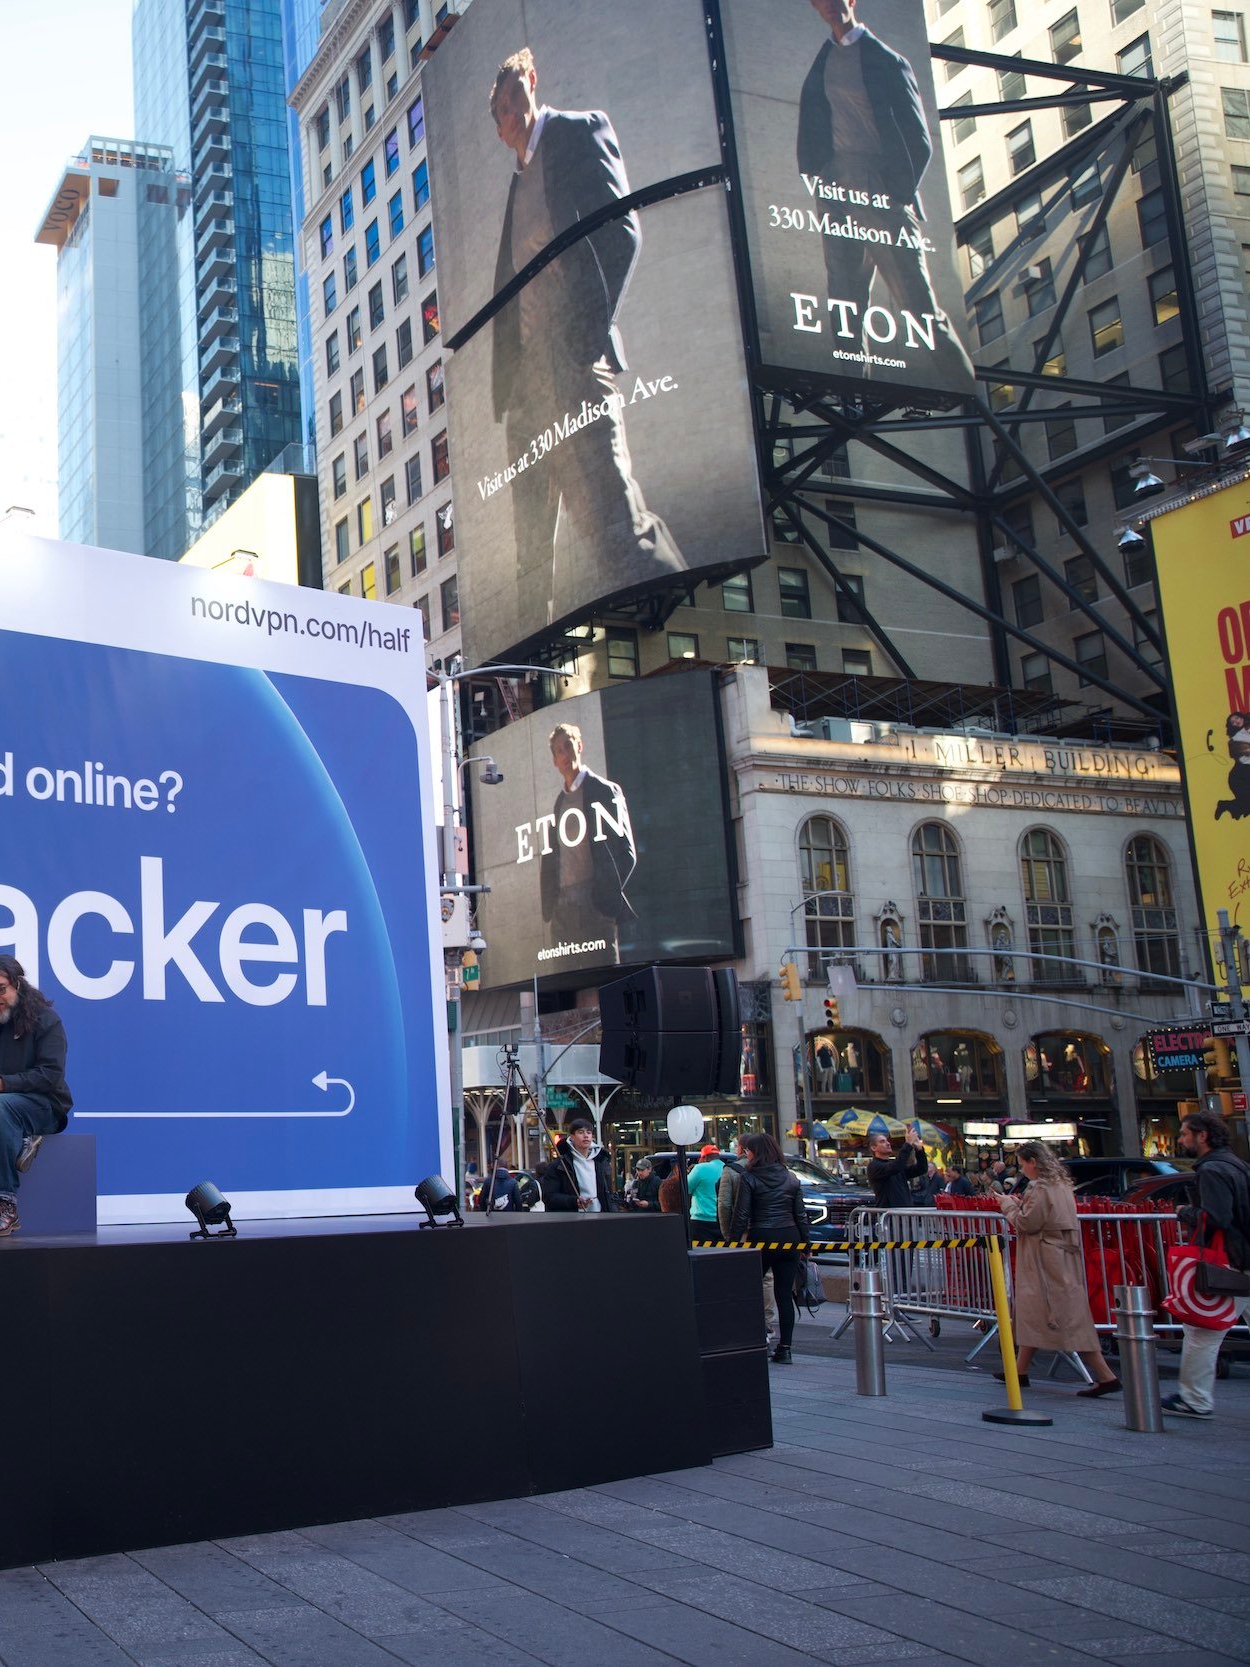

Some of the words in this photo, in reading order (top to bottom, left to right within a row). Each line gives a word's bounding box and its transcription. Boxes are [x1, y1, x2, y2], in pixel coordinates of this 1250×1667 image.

[801, 173, 846, 202] Visit
[849, 189, 869, 206] us
[872, 192, 890, 209] at
[768, 205, 804, 230] 330
[807, 210, 892, 246] Madison
[895, 226, 936, 253] Ave.
[790, 292, 935, 351] ETON
[833, 349, 906, 369] etonshirts.com
[477, 471, 503, 500] Visit
[504, 461, 517, 482] us
[517, 453, 530, 473] at
[530, 429, 553, 465] 330
[553, 393, 627, 446] Madison
[629, 375, 679, 405] Ave.
[191, 596, 410, 652] nordvpn.com/half
[935, 741, 1024, 767] MILLER
[1043, 750, 1149, 775] BUILDING
[26, 761, 184, 813] online?
[778, 773, 809, 791] THE
[815, 776, 860, 794] SHOW
[868, 780, 917, 798] FOLKS
[922, 783, 967, 802] SHOE
[969, 787, 1007, 804] SHOP
[1012, 790, 1092, 809] DEDICATED
[1096, 796, 1119, 811] TO
[515, 797, 625, 864] ETON
[537, 939, 606, 961] etonshirts.com
[1217, 1025, 1230, 1033] ONE
[1237, 1023, 1250, 1031] WAY
[1157, 1055, 1198, 1067] CAMERA
